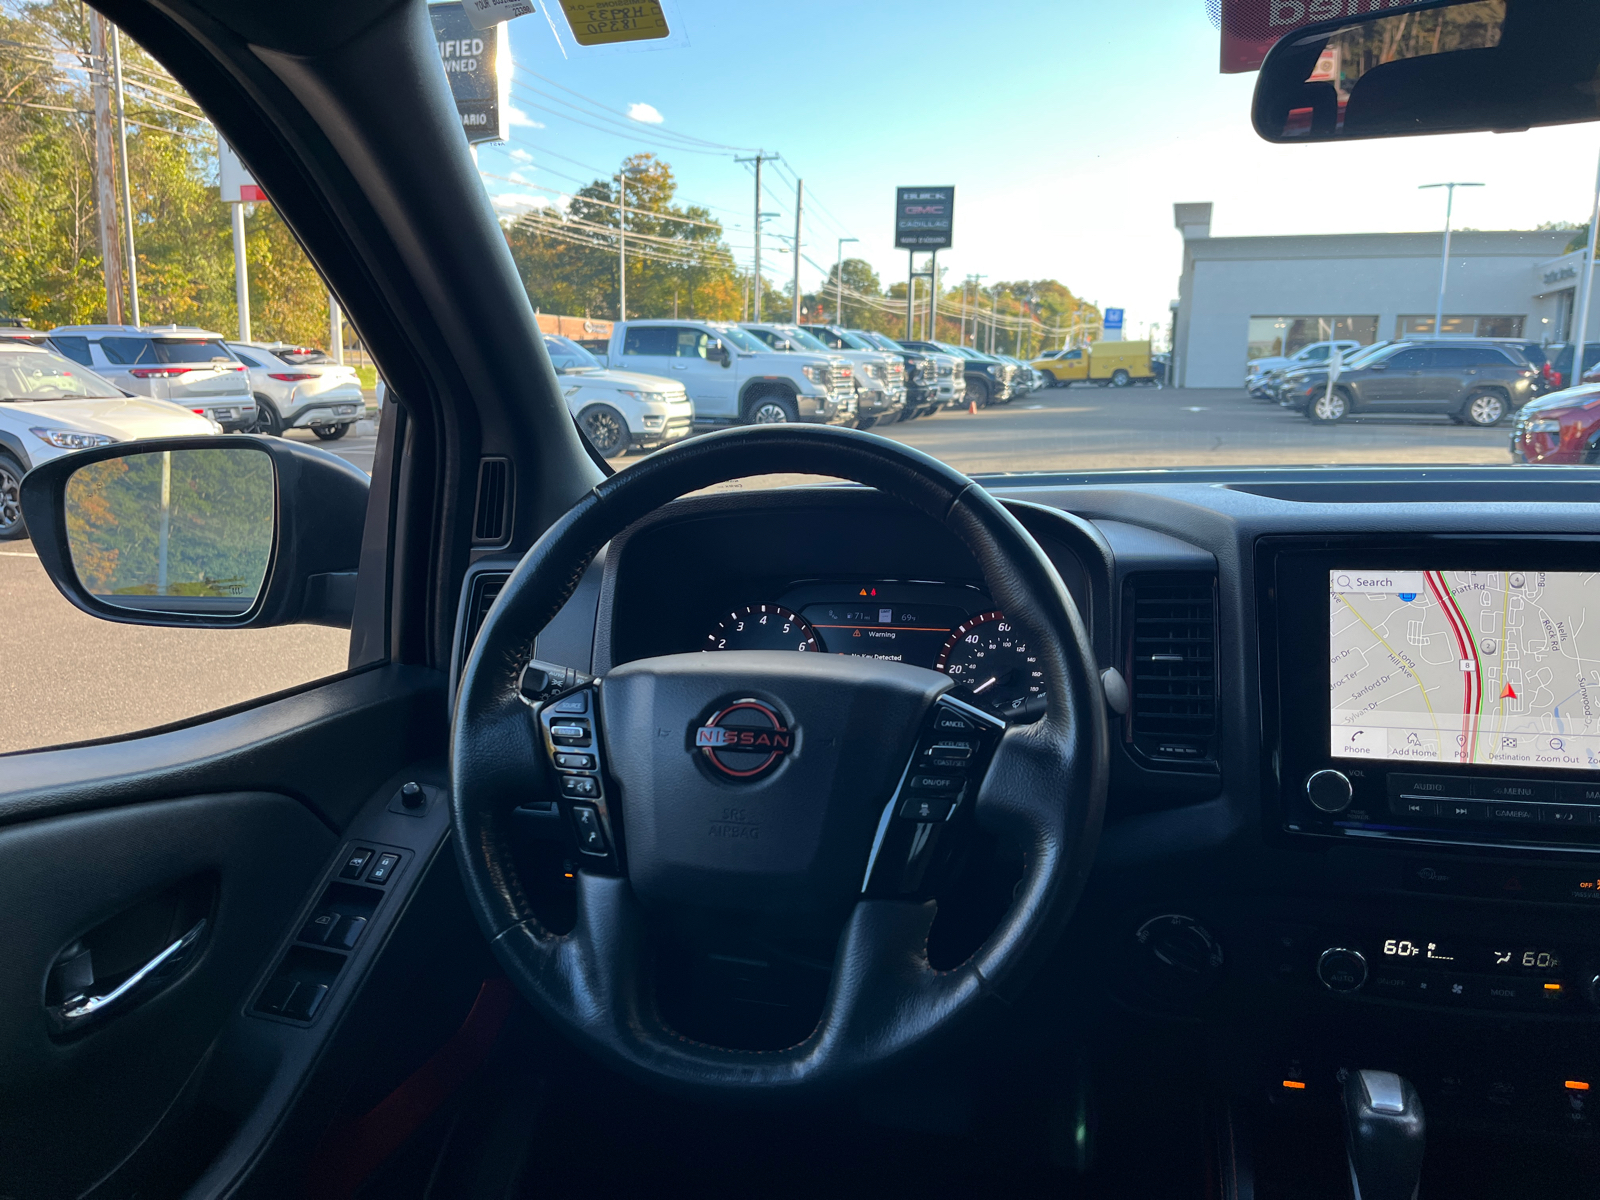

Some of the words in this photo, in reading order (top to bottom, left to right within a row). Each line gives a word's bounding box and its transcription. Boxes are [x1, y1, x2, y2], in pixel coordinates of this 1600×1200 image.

[474, 1, 491, 11] YOUR
[439, 38, 484, 58] IFIED
[905, 206, 944, 214] GMC
[1356, 578, 1393, 587] Search
[1451, 584, 1471, 596] Platt
[760, 615, 767, 625] 4
[736, 622, 744, 631] 3
[782, 624, 790, 633] 5
[998, 623, 1011, 632] 60
[868, 631, 896, 639] Warning
[1542, 619, 1556, 640] Rock
[1550, 640, 1560, 652] Rd
[1555, 621, 1568, 642] Nells
[718, 639, 726, 648] 2
[965, 635, 979, 643] 40
[798, 642, 806, 651] 6
[1340, 649, 1351, 658] Dr
[1397, 650, 1416, 669] Long
[949, 665, 962, 674] 20
[1387, 653, 1399, 666] Hill
[1399, 665, 1413, 679] Ave
[549, 671, 565, 679] AUTO
[1344, 671, 1358, 681] Ter
[1351, 680, 1381, 700] Sanford
[1380, 675, 1391, 684] Dr
[1578, 677, 1593, 716] Sunwood
[1344, 707, 1368, 723] Sylvan
[1368, 701, 1378, 710] Dr
[941, 720, 965, 728] CANCEL
[699, 730, 789, 747] NISSAN
[1344, 745, 1370, 754] Phone
[1391, 748, 1410, 756] Add
[1412, 749, 1437, 757] Home
[1489, 753, 1530, 761] Destination
[1535, 755, 1560, 763] Zoom
[1562, 755, 1579, 763] Out
[1349, 769, 1365, 778] VOL
[922, 778, 951, 787] ON/OFF
[1414, 782, 1444, 792] AUDIO
[1503, 788, 1533, 797] MENU
[1585, 791, 1600, 799] MA
[722, 808, 746, 820] SRS
[1495, 809, 1530, 818] CAMERA
[709, 825, 759, 839] AIRBAG
[1331, 974, 1354, 982] AUTO
[1491, 988, 1515, 997] MODE
